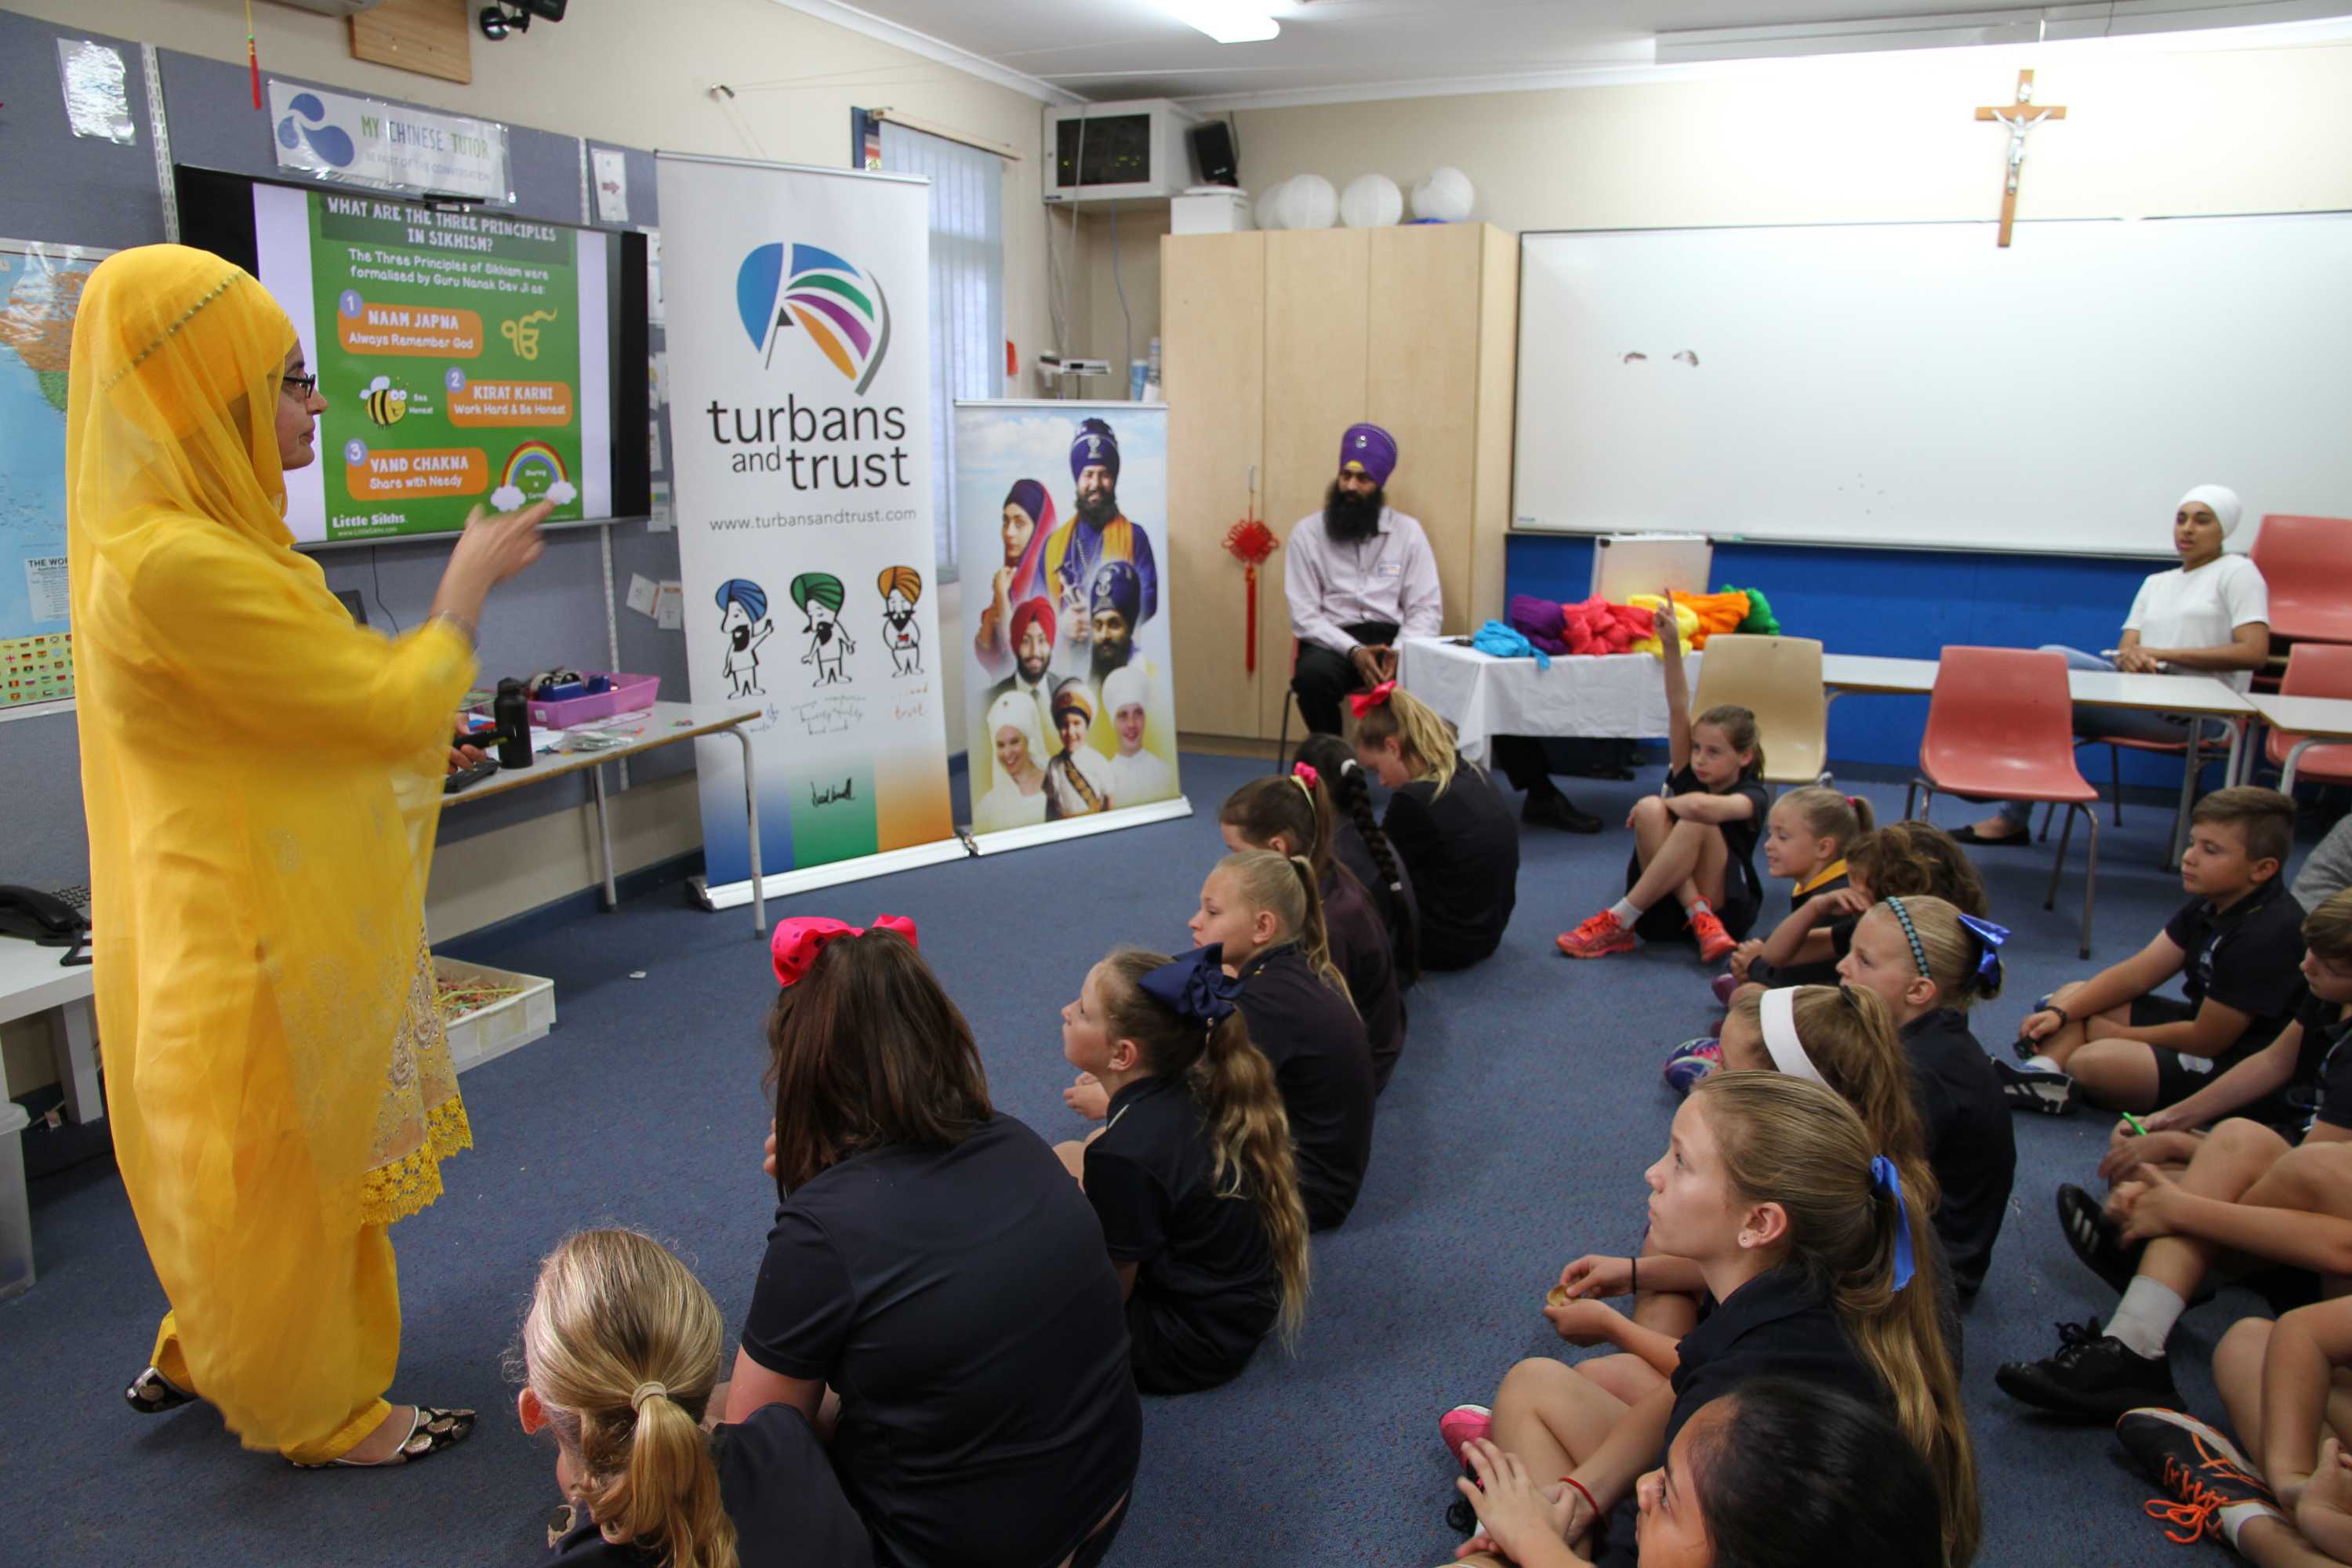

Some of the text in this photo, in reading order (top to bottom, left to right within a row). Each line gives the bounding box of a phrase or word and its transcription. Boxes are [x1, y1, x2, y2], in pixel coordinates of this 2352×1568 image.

[361, 114, 490, 158] MY CHINESE TUTOR
[328, 197, 557, 241] WHAT ARE THE THREE PRINCIPLES
[408, 228, 493, 252] IN SIKHISM?
[348, 247, 549, 280] The Three Principles of Sikhism were
[350, 266, 546, 295] formalised by Guru Nanak Dev Ji as:
[347, 294, 354, 311] 1
[368, 310, 459, 330] NAAM JAPNA
[349, 332, 474, 349] Always Remember God
[451, 372, 460, 387] 2
[473, 386, 553, 401] KIRAT KARNI
[453, 403, 565, 415] Work Hard & Be Honest
[706, 394, 906, 445] turbans
[350, 443, 361, 461] 3
[370, 456, 469, 474] VAND CHAKNA
[731, 445, 910, 492] and trust
[369, 474, 463, 490] Share with Needy
[332, 512, 405, 528] Little Sikhs
[710, 507, 916, 532] www.turbansandtrust.com
[27, 559, 47, 568] THE
